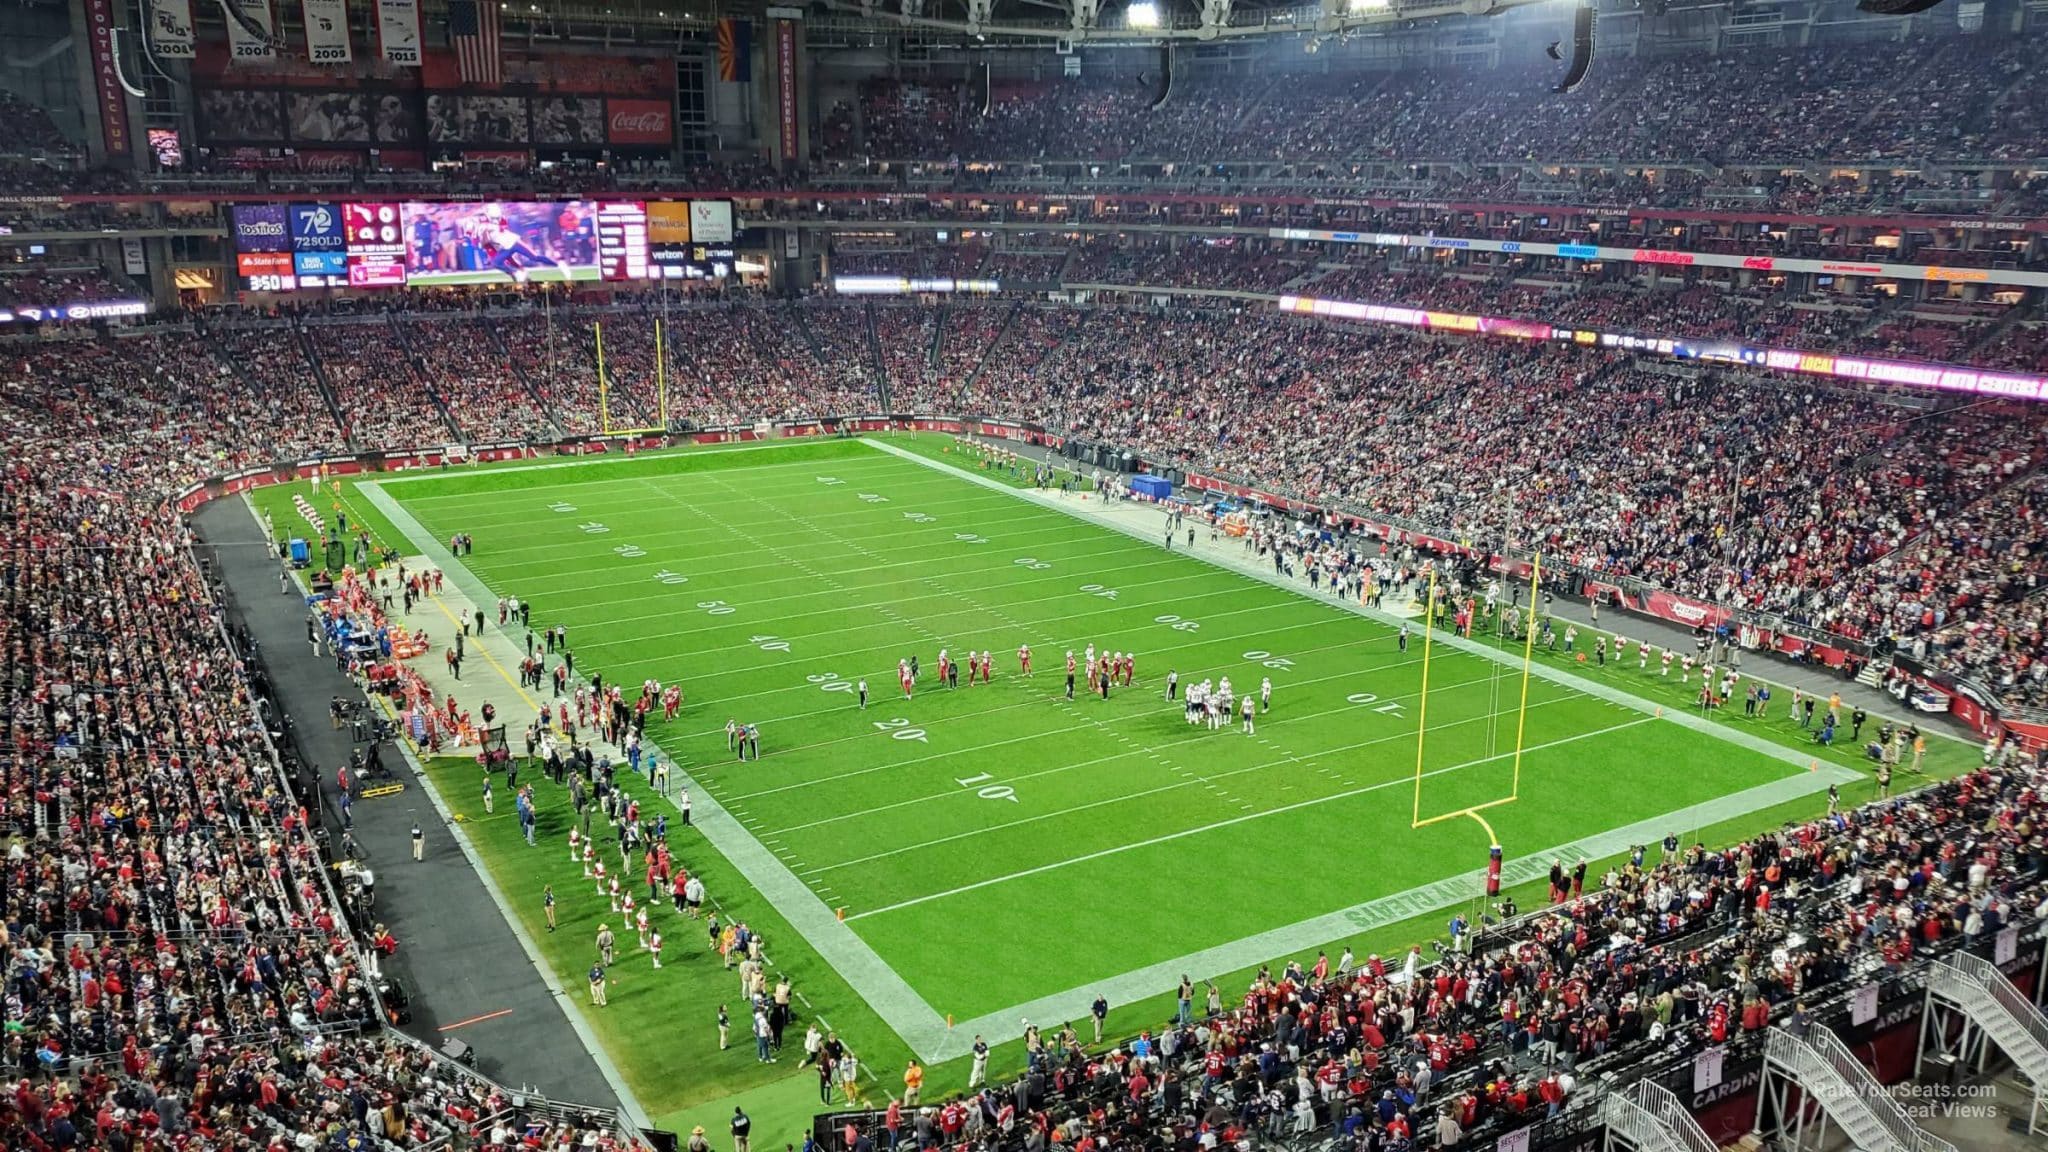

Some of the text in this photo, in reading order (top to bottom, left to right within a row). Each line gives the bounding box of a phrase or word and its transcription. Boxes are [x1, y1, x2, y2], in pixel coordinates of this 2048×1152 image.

[314, 49, 346, 59] 2009
[387, 52, 417, 61] 2015
[300, 207, 332, 234] 72
[1950, 221, 2025, 230] ROGER WEHRLI
[294, 236, 342, 248] 72SOLD
[1502, 243, 1520, 252] COX
[652, 250, 684, 259] verizon
[302, 262, 324, 270] LIGHT
[250, 275, 280, 291] 3:50
[91, 303, 146, 316] HYUNDAI
[1801, 355, 1833, 372] LOCAL
[697, 600, 736, 615] 50
[1154, 615, 1199, 631] 30
[748, 634, 790, 651] 40
[1242, 650, 1296, 669] 20
[806, 672, 852, 692] 30
[1347, 693, 1406, 714] 10
[872, 717, 927, 740] 20
[955, 771, 1014, 799] 10
[1344, 891, 1438, 929] CLEATS
[1693, 1069, 1760, 1109] CARDIN
[1501, 1130, 1528, 1147] SECTION
